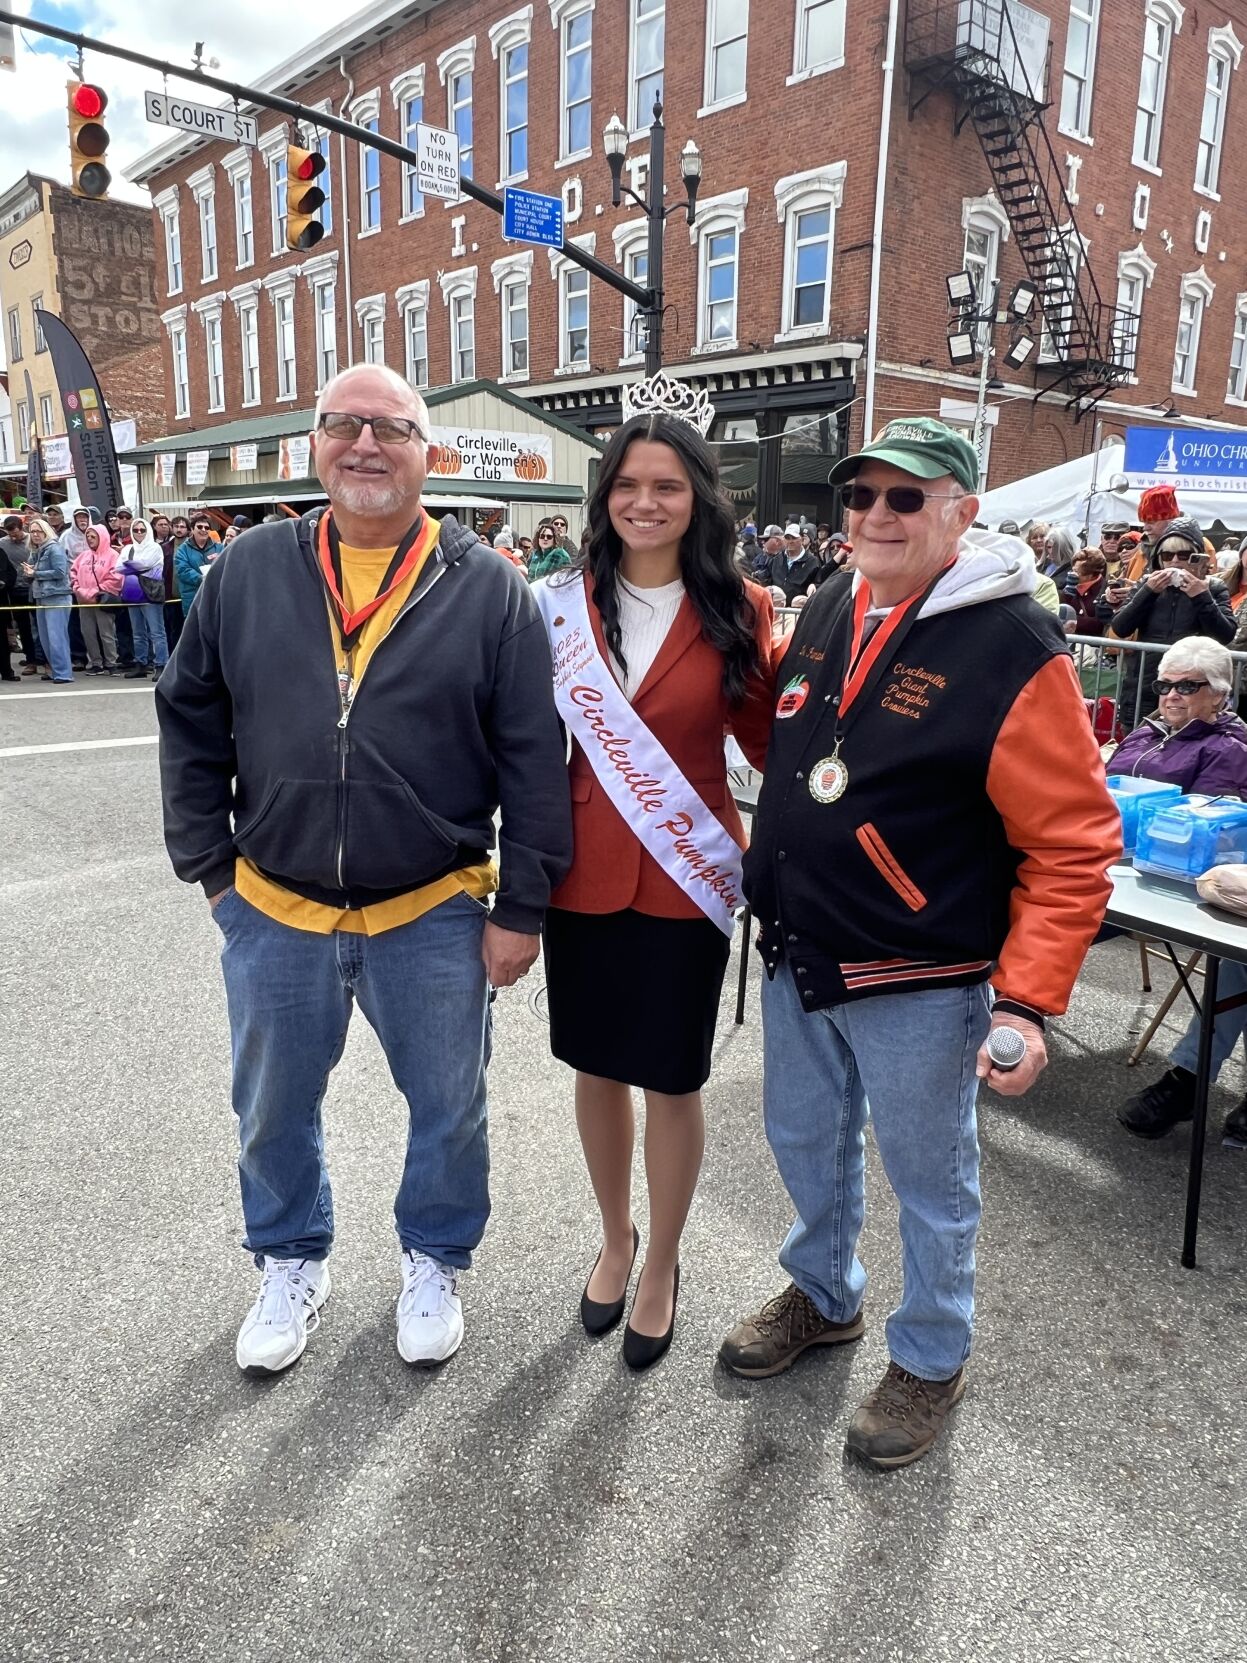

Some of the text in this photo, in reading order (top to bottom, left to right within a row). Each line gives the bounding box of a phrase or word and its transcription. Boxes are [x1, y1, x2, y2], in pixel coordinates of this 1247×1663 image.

[151, 99, 252, 139] S COURT ST
[430, 132, 446, 146] NO
[425, 145, 451, 163] TURN
[420, 160, 457, 179] ON RED
[514, 201, 549, 214] POLICE STATION
[526, 197, 543, 206] STATION
[514, 208, 552, 221] MUNICIPAL COURT
[514, 215, 529, 223] COURT
[457, 435, 517, 452] Circleville
[1182, 442, 1218, 458] OHIO
[80, 431, 99, 491] Station
[94, 430, 117, 508] Inspiratio
[437, 451, 537, 469] Junior Women's
[473, 466, 502, 480] Club
[553, 638, 588, 678] Queen
[893, 662, 946, 689] Circleville
[901, 677, 929, 693] Giant
[885, 684, 929, 707] Pumpkin
[881, 696, 920, 718] Growers
[570, 685, 738, 908] Circleville Pumpkin
